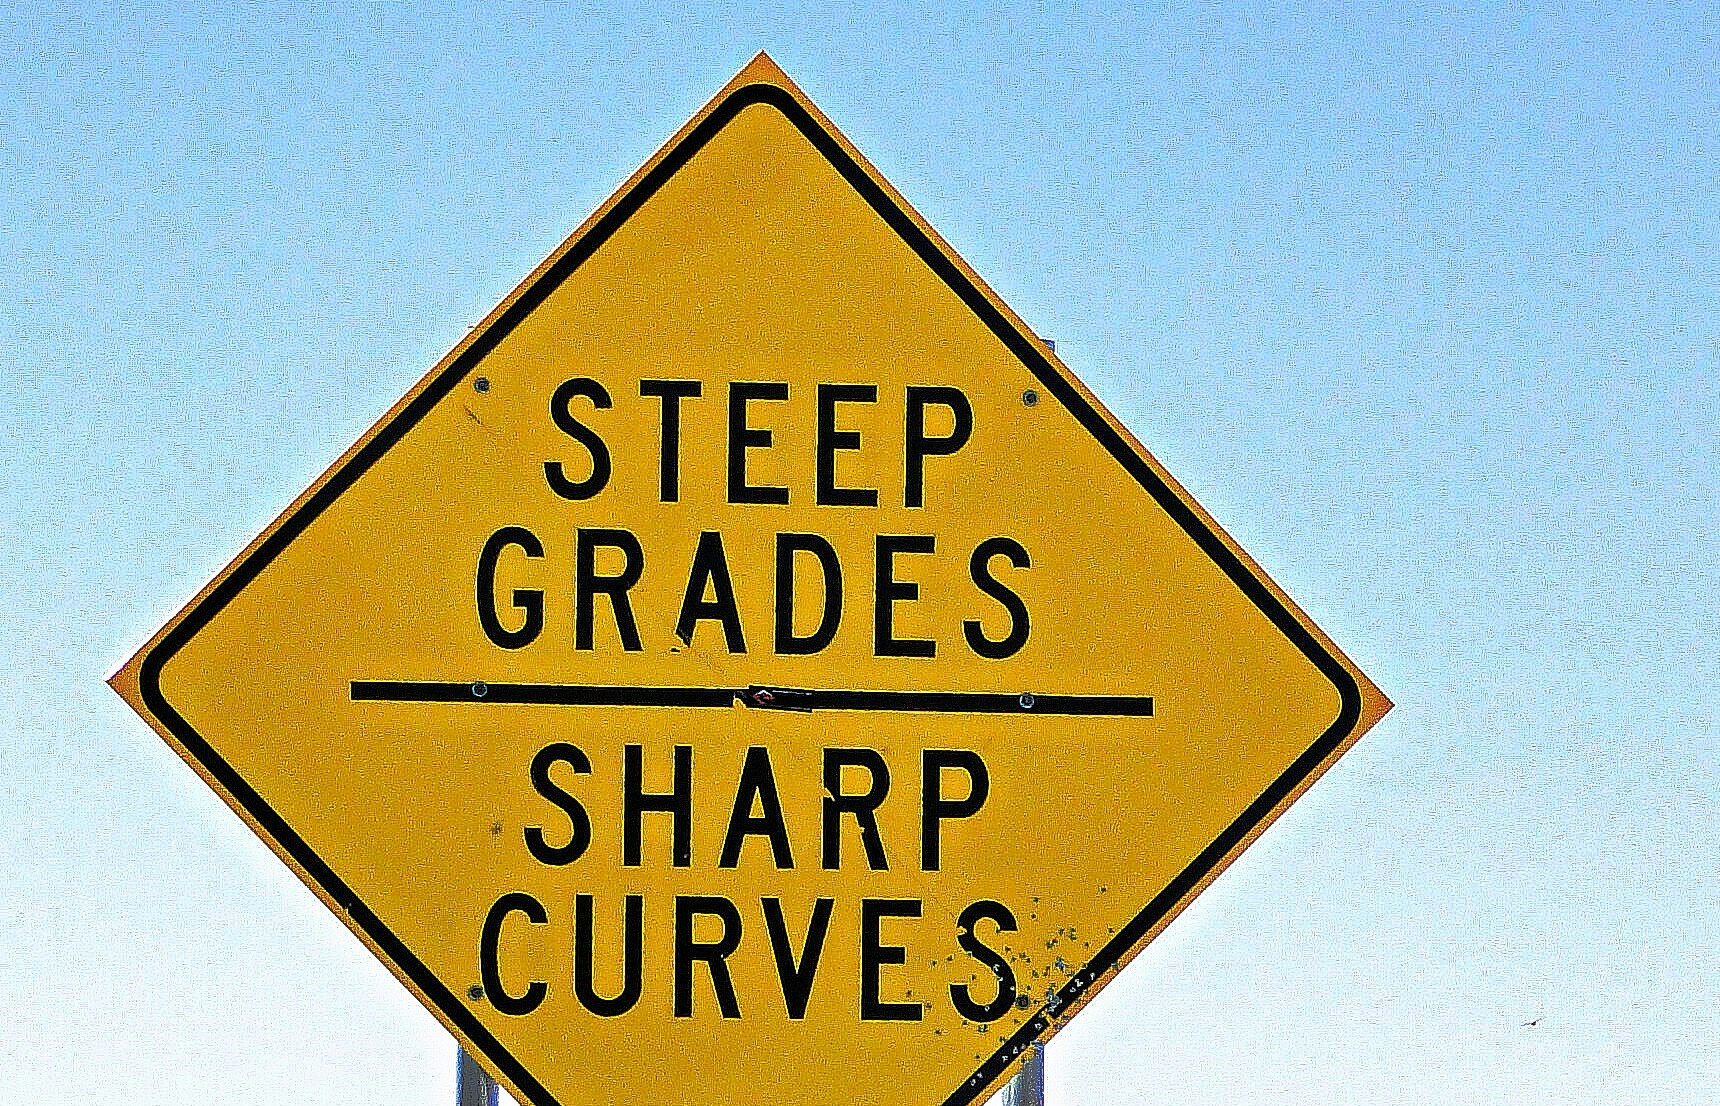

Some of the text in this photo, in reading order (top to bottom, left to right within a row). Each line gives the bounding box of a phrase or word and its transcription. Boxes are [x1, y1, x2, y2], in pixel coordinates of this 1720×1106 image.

[544, 378, 973, 508] STEEP
[477, 527, 1030, 659] GRADES
[524, 743, 989, 871] SHARP
[481, 893, 1018, 1023] CURVES
